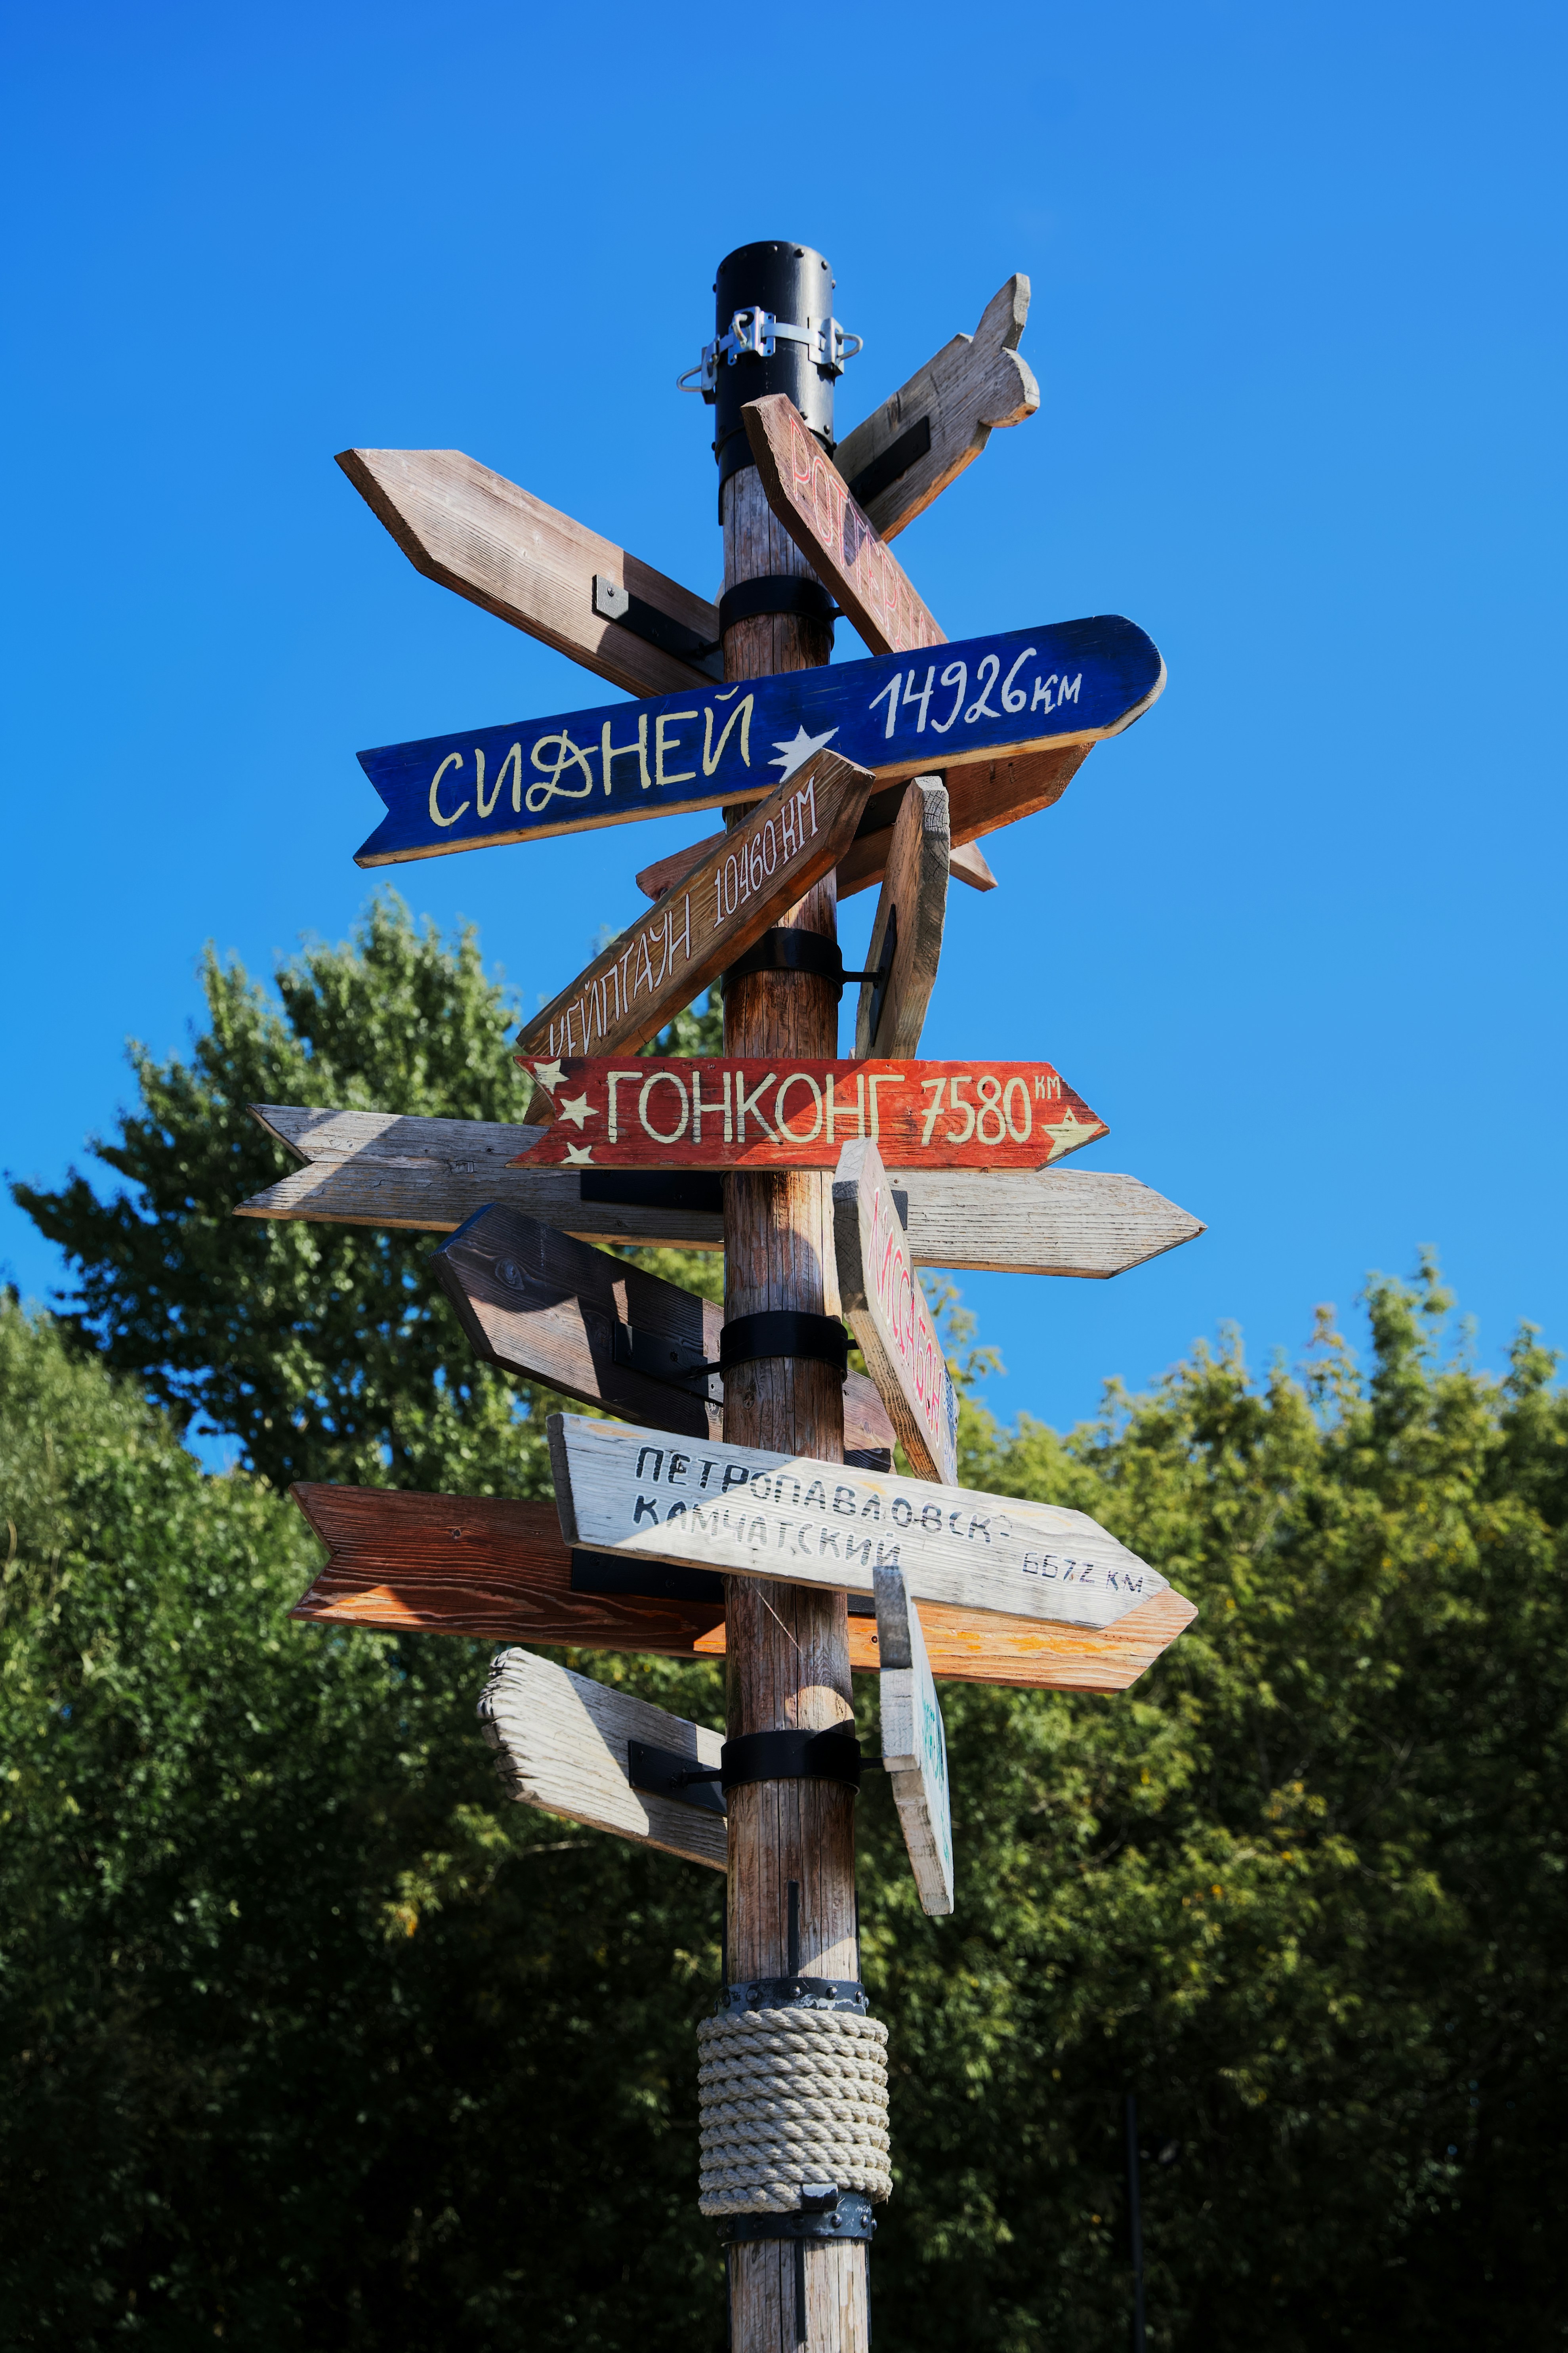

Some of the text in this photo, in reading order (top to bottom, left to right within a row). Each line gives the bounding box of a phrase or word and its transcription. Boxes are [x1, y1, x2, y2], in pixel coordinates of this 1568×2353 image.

[429, 685, 754, 827] СИДНЕЙ
[868, 647, 1037, 739] 14926
[713, 820, 777, 928] 10460
[606, 1070, 906, 1144] ГОНКОНГ
[920, 1075, 1033, 1146] 7580
[632, 1493, 901, 1566] КАМЧАТСКИЙ
